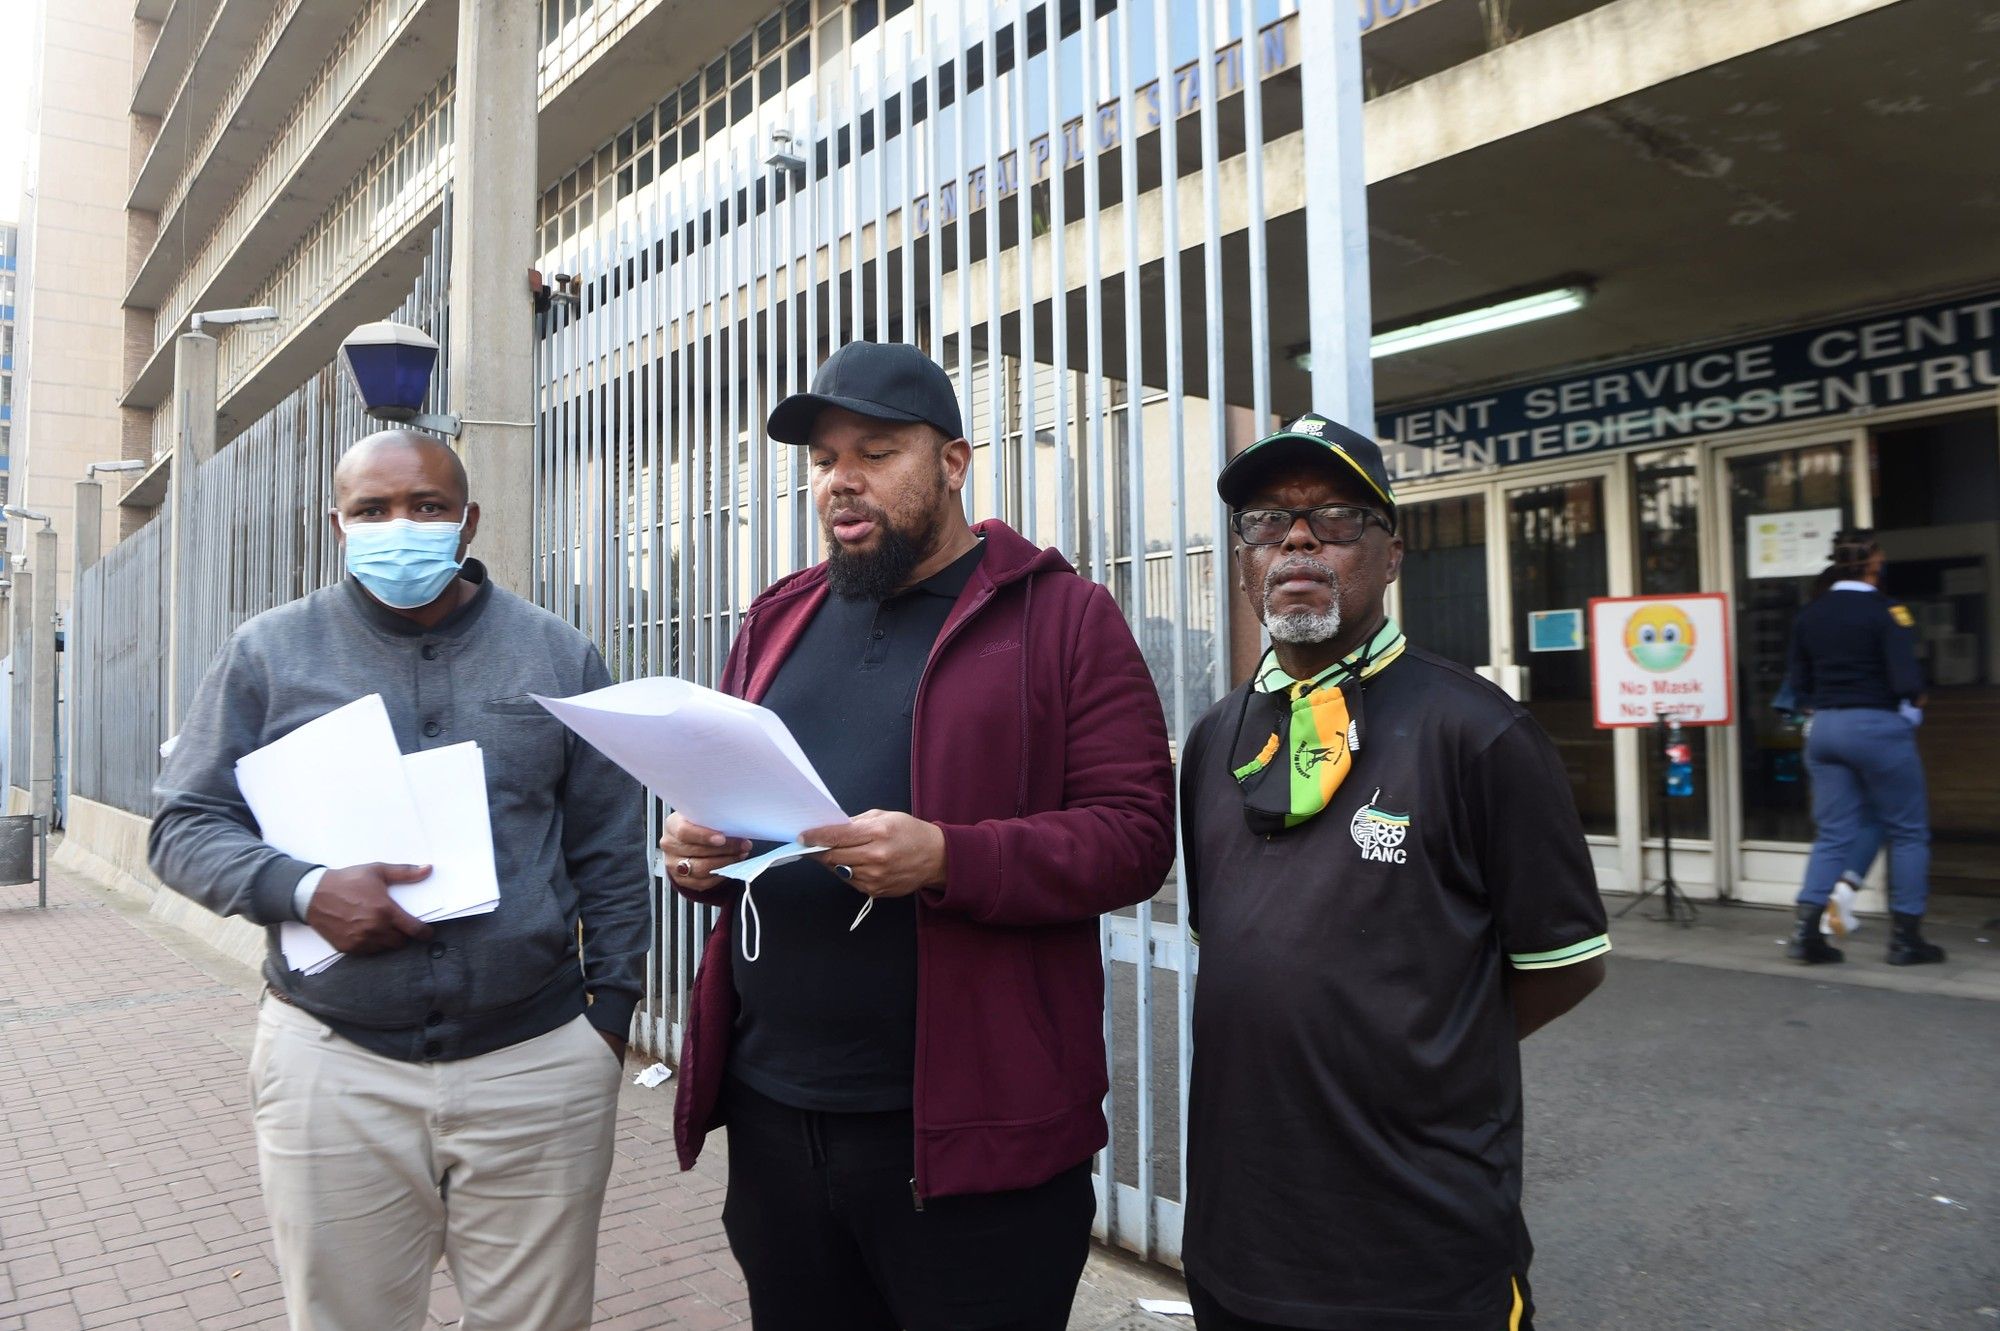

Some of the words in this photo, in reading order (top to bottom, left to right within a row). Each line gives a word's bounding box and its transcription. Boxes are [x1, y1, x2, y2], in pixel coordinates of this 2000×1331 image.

[1375, 399, 1498, 445] LIENT
[1524, 345, 1775, 419] SERVICE
[1808, 301, 2000, 367] CENT
[1383, 350, 2000, 480] LIËNTEDIENSSENTRU
[1619, 681, 1648, 696] No
[1653, 679, 1704, 694] Mask
[1619, 703, 1648, 717] No
[1369, 846, 1407, 864] ANC
